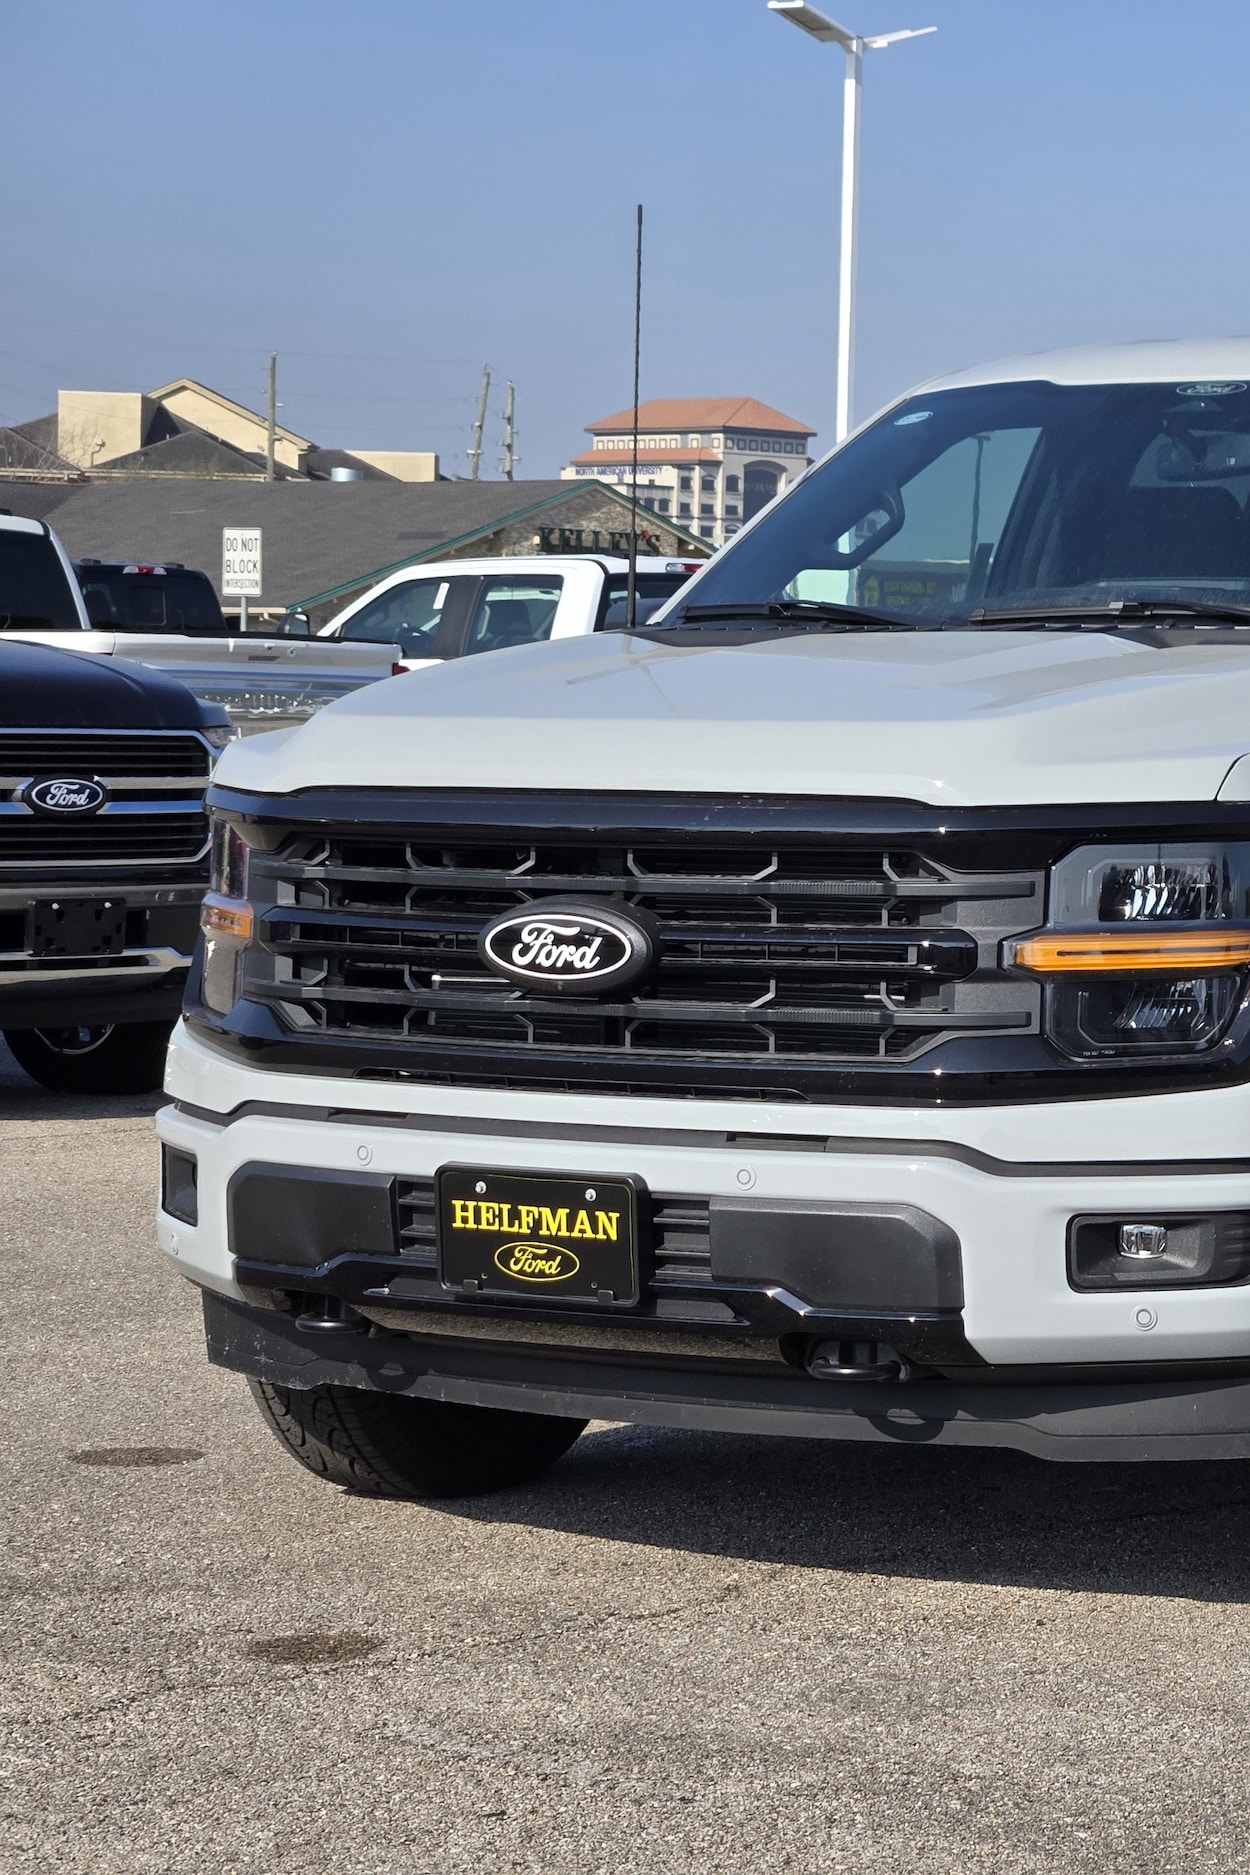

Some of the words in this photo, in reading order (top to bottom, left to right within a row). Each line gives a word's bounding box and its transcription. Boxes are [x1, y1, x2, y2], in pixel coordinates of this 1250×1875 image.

[575, 466, 594, 476] NORTH
[597, 465, 627, 476] AMERICAN
[629, 465, 663, 476] UIVERSITY
[226, 537, 238, 552] DO
[241, 537, 259, 552] NOT
[225, 559, 259, 574] BLOCK
[225, 578, 259, 589] INTERSECTION
[45, 783, 91, 805] Ford
[512, 922, 603, 969] Ford
[451, 1199, 620, 1241] HELFMAN
[510, 1245, 561, 1275] Ford
